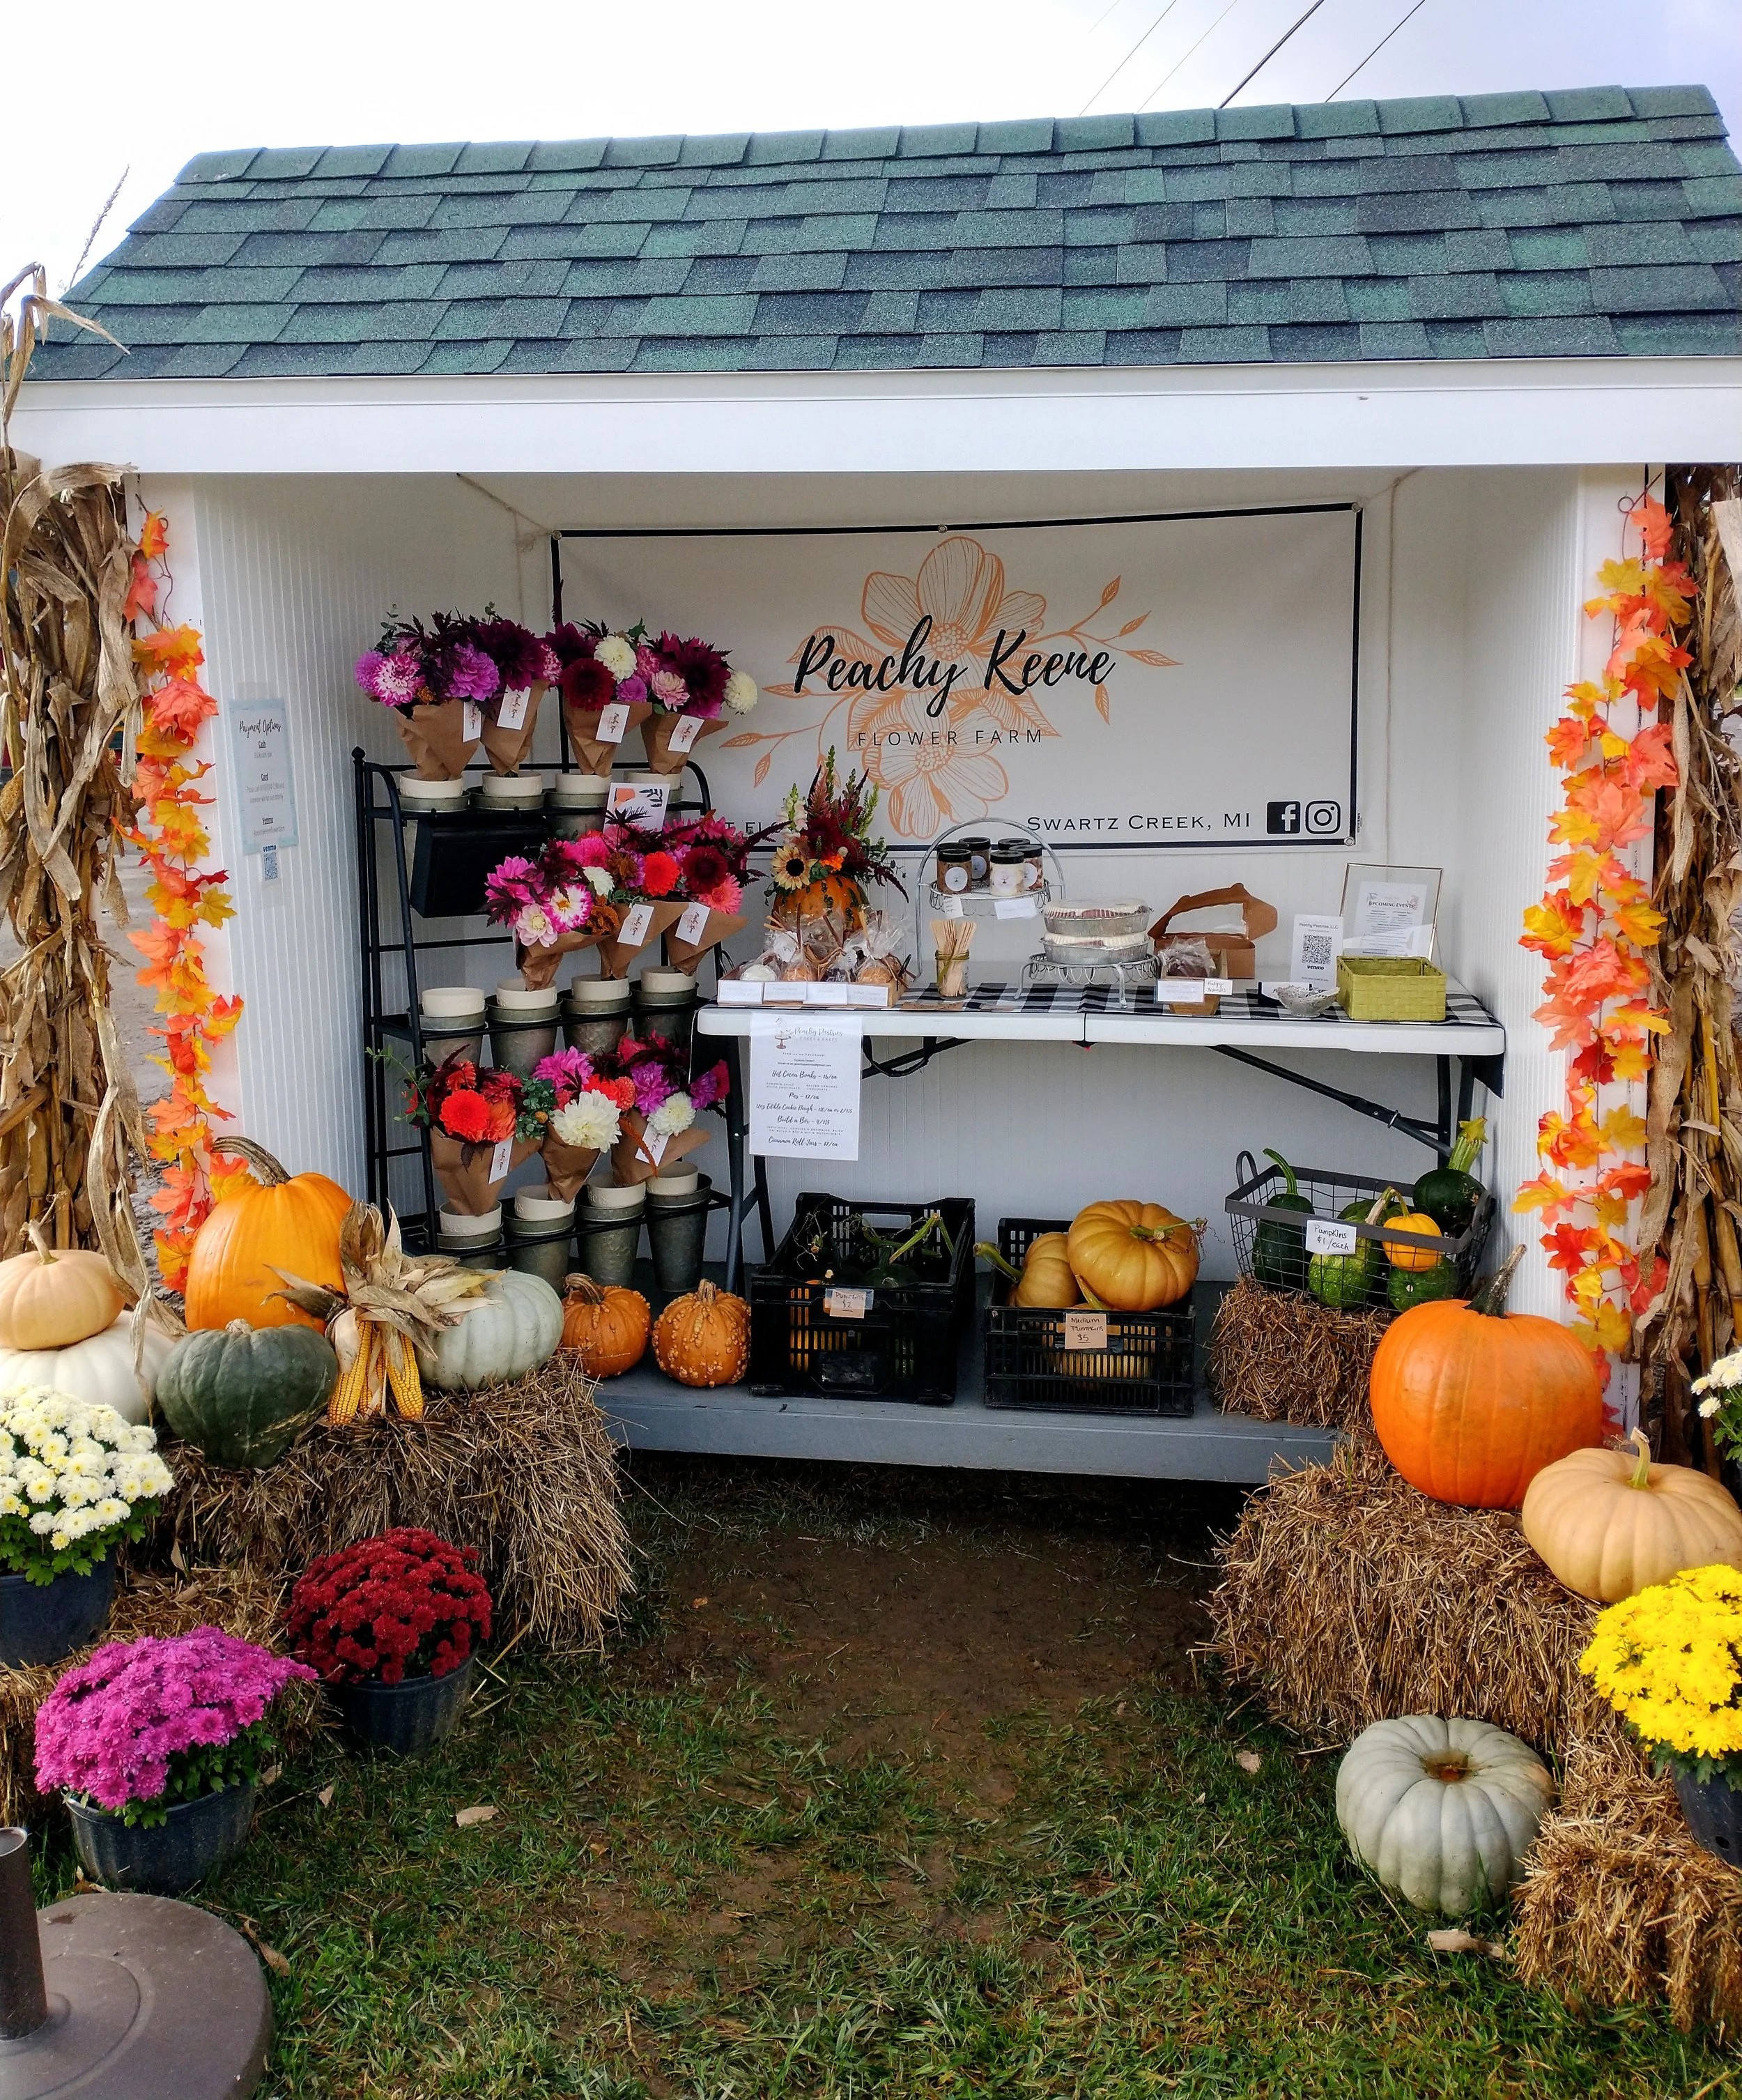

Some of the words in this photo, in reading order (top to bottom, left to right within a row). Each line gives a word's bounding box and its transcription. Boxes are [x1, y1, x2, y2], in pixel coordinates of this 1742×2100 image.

[794, 615, 967, 717] Peachy
[984, 629, 1116, 695] Keene
[239, 719, 261, 739] Payment
[263, 719, 281, 736] Options
[857, 729, 959, 746] FLOWER
[976, 728, 1042, 744] FARM
[1027, 814, 1119, 832] SWARTZ
[1128, 813, 1212, 831] CREEK,
[1224, 812, 1250, 828] MI
[799, 1071, 817, 1080] Bombs
[798, 1104, 813, 1114] Dough
[792, 1137, 806, 1147] Roll
[1314, 1224, 1347, 1239] Pumpkins
[842, 1299, 852, 1308] $2
[1077, 1333, 1089, 1342] $5
